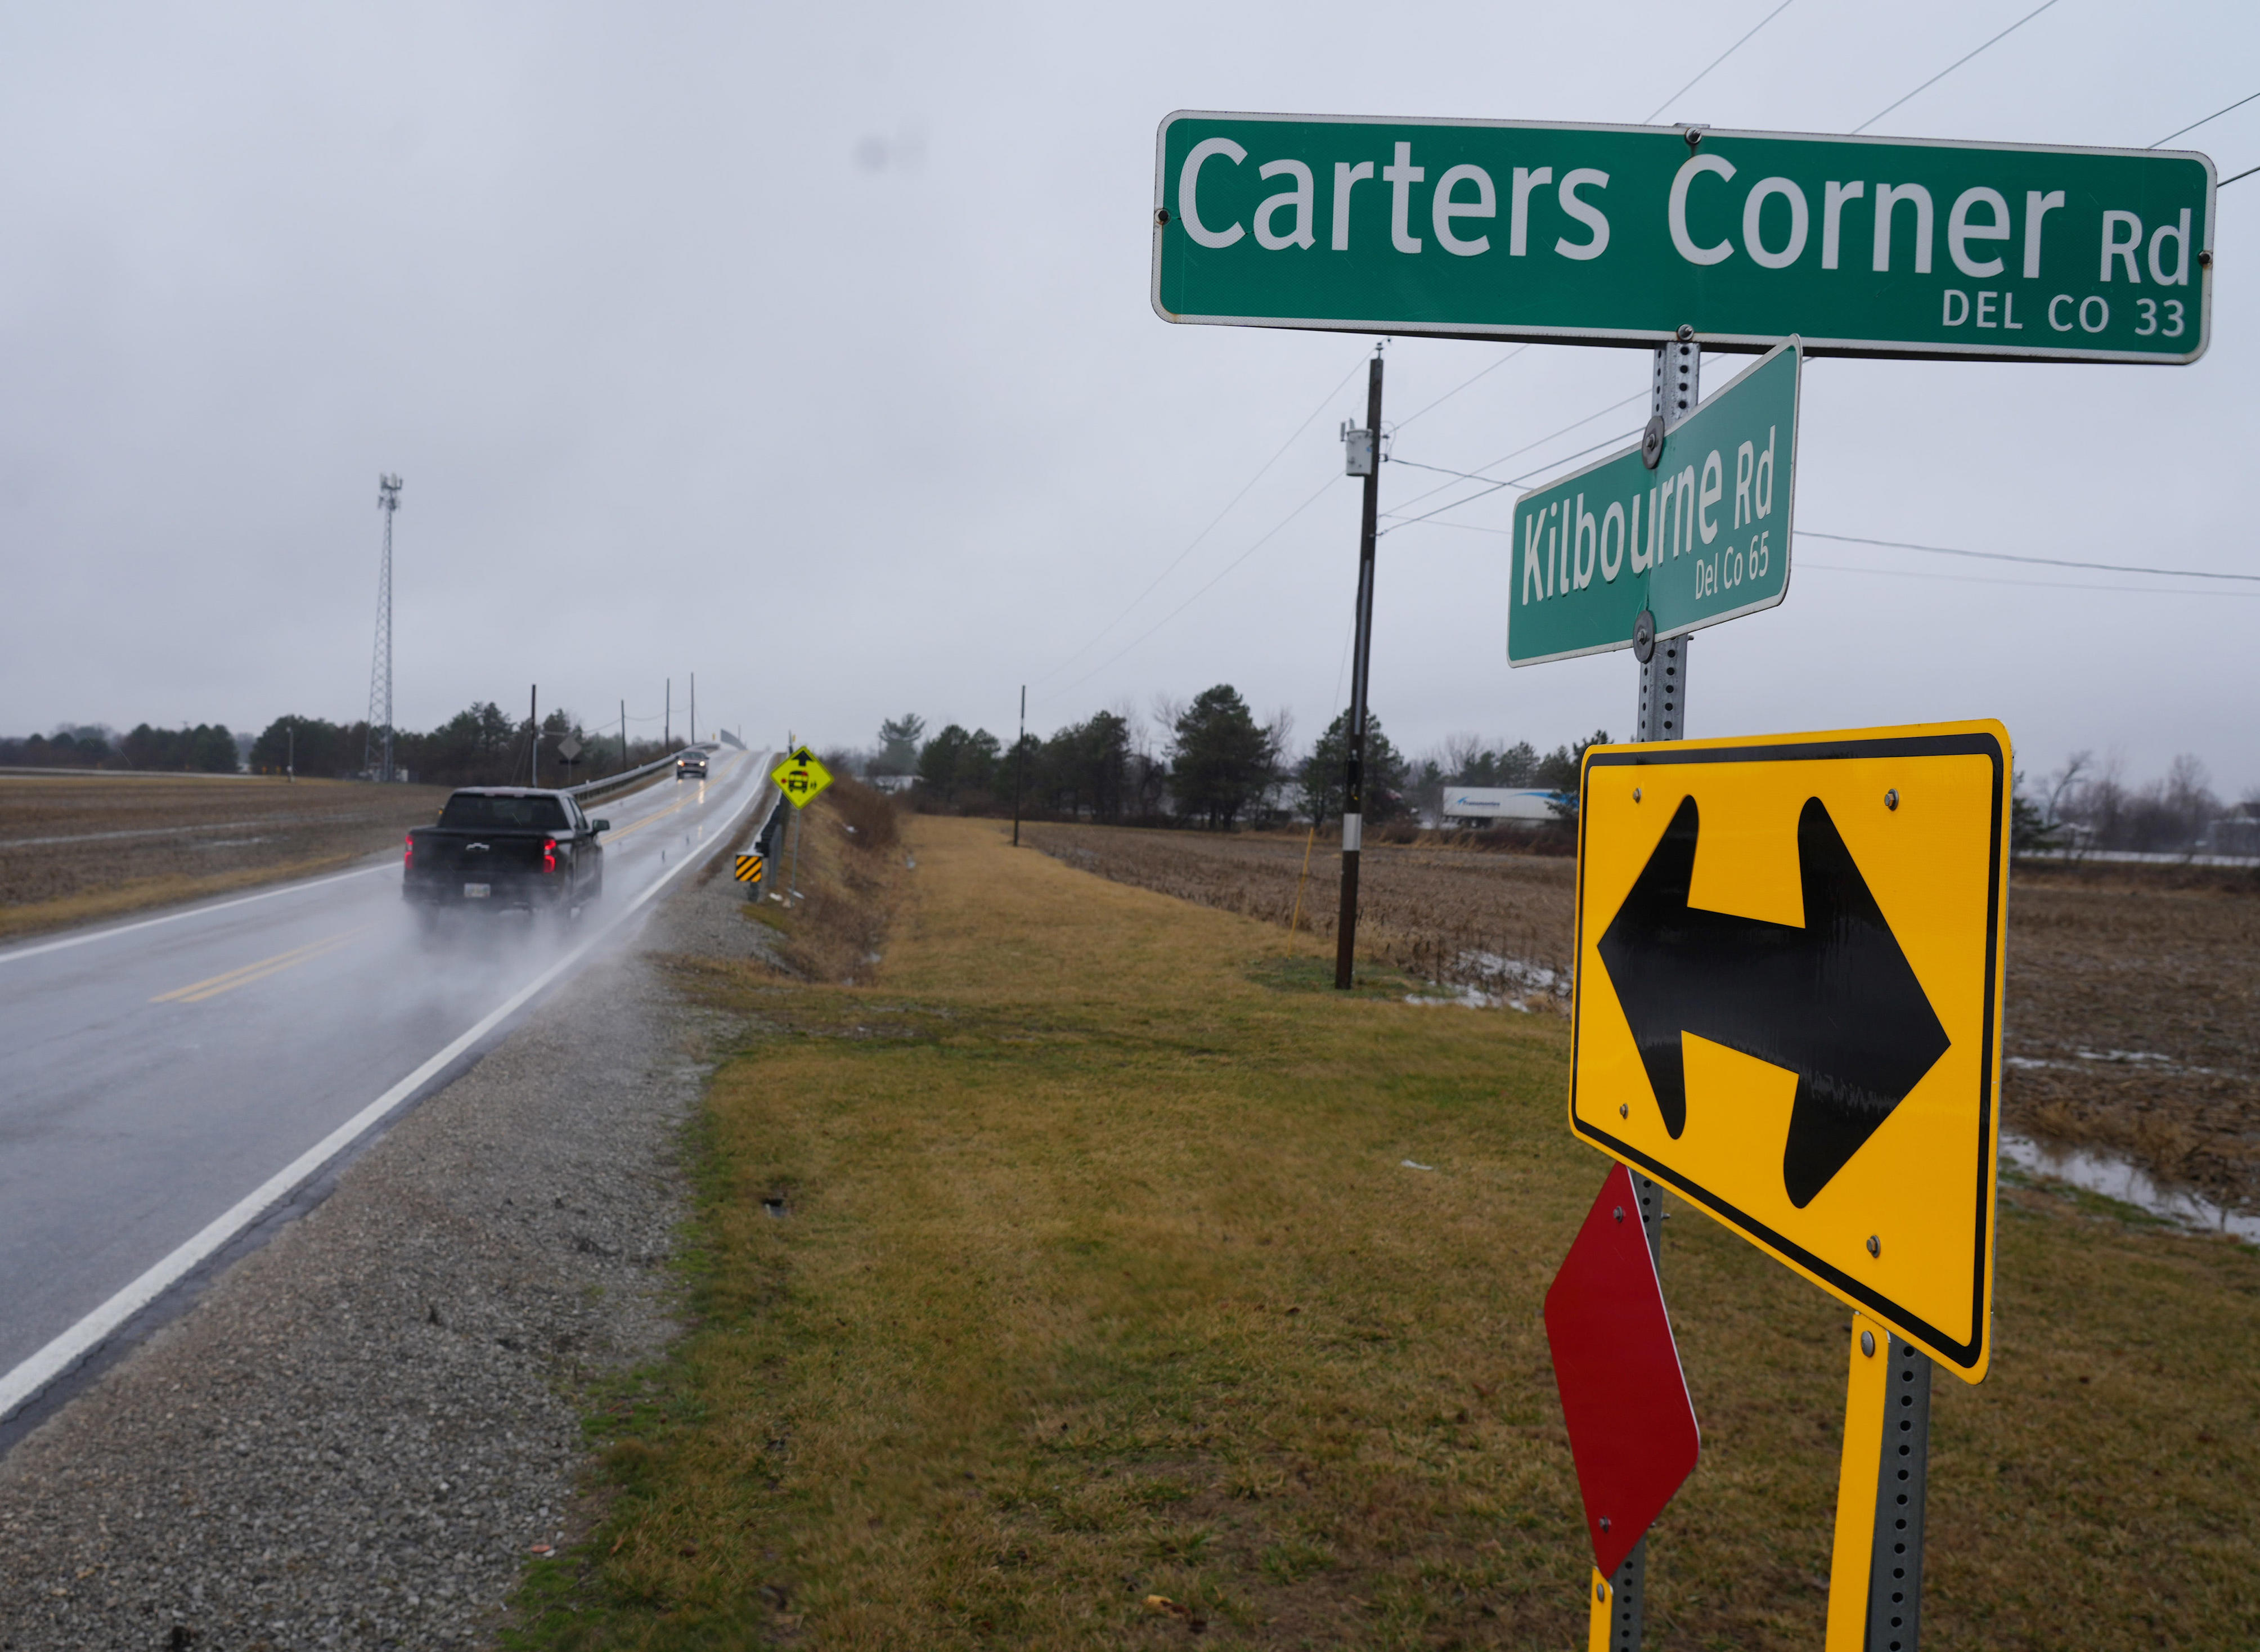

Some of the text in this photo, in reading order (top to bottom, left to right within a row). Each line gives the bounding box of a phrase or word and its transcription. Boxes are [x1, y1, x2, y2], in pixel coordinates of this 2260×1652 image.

[1179, 137, 2191, 286] Carters Corner Rd
[1943, 289, 2184, 337] DEL CO 33
[1522, 425, 1776, 606] Kilbourne Rd
[1696, 530, 1769, 600] Del Co 65
